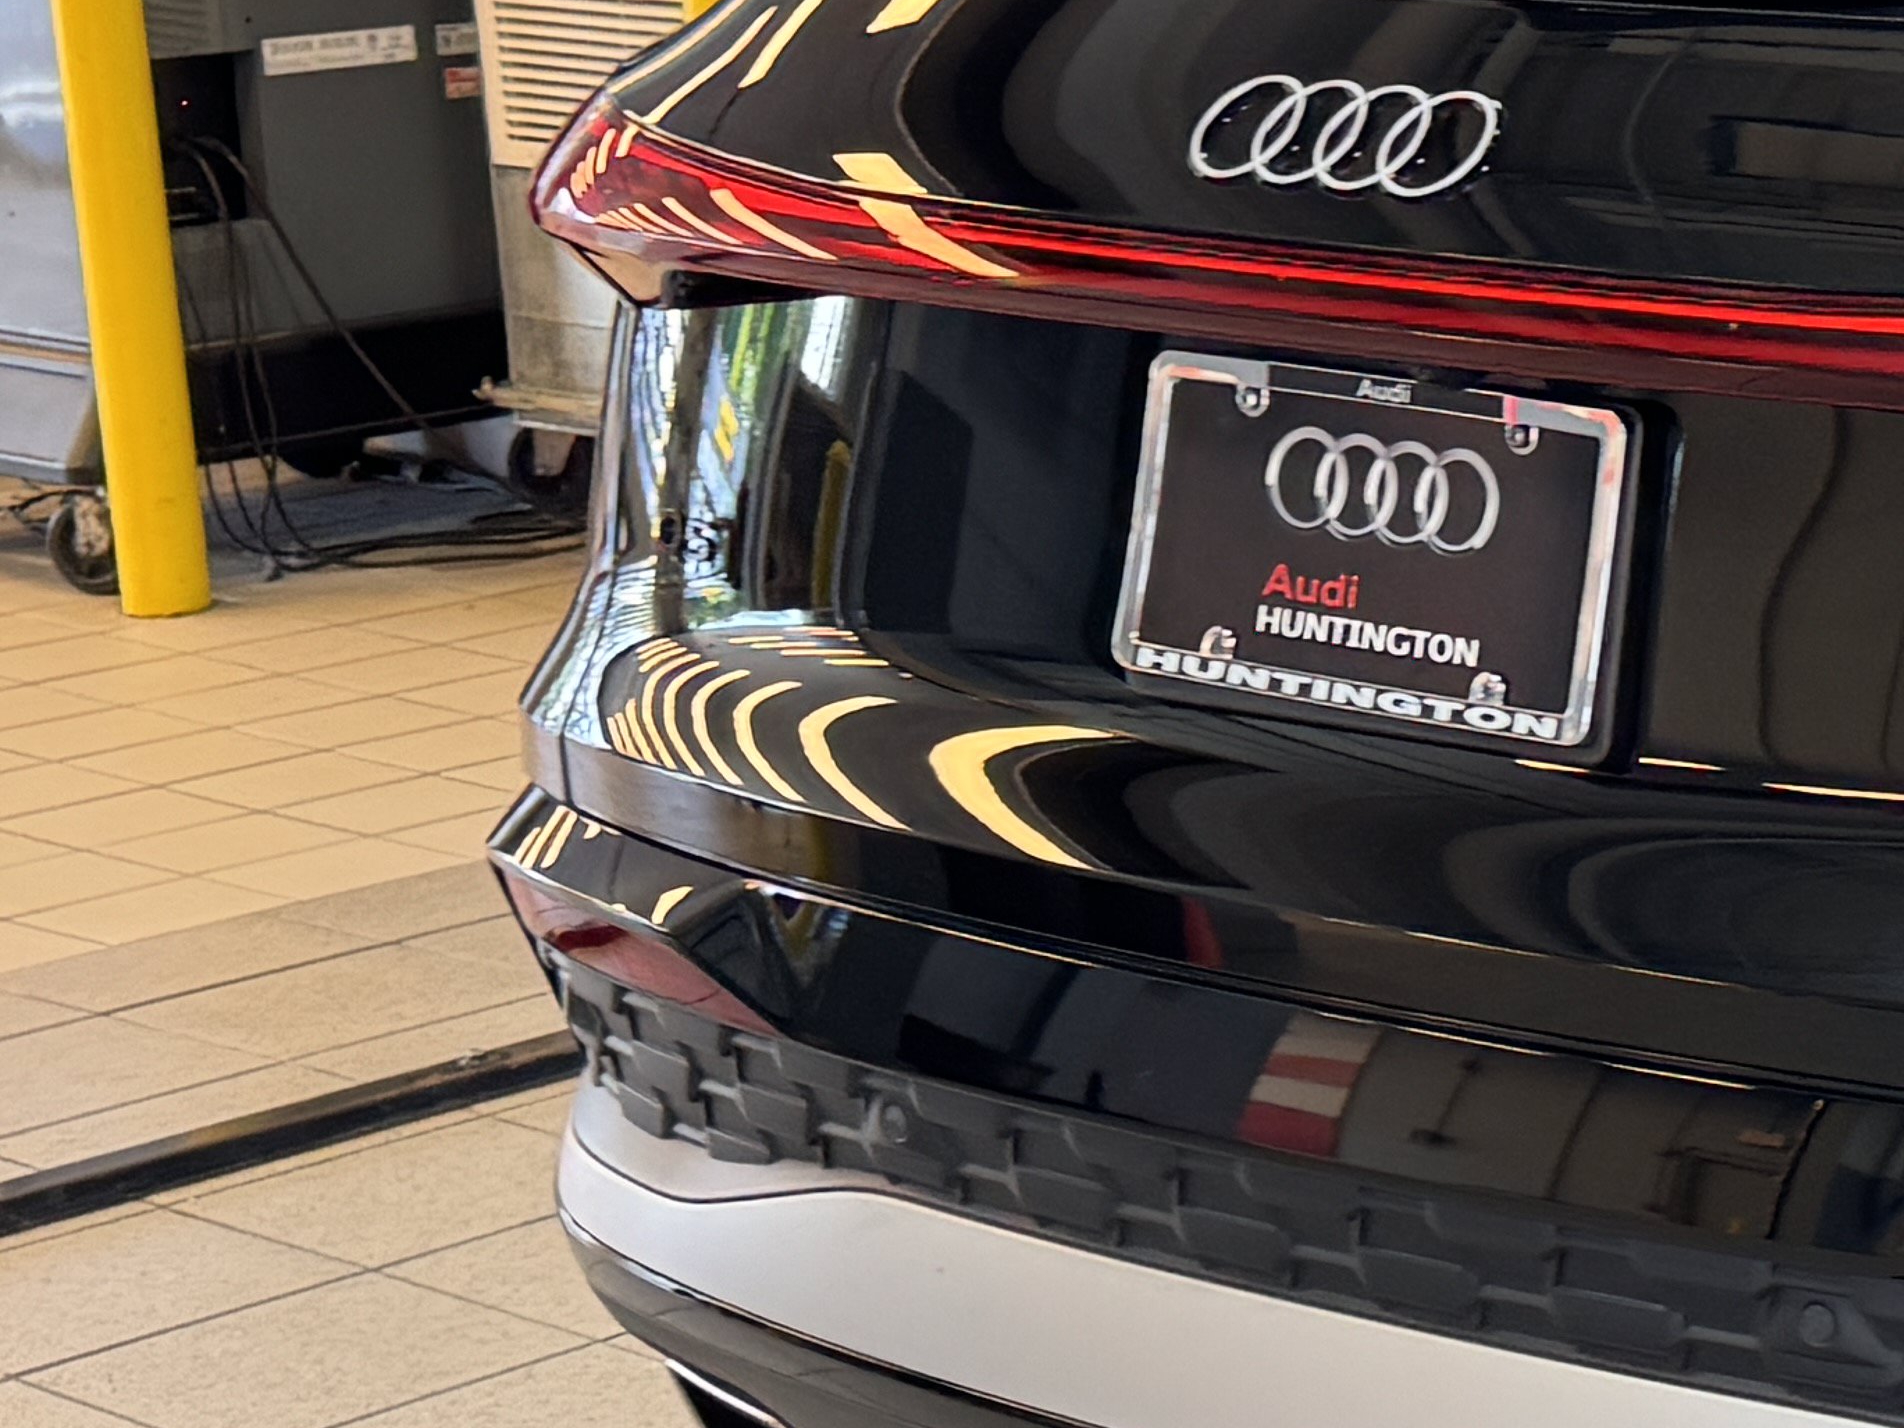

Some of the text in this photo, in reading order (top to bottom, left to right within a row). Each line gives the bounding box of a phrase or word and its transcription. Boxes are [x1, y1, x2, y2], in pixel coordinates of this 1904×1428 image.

[1355, 378, 1413, 404] Audi
[1261, 563, 1360, 609] Audi
[1255, 605, 1480, 668] HUNTINGTON
[1135, 646, 1560, 741] HUNTINGTON
